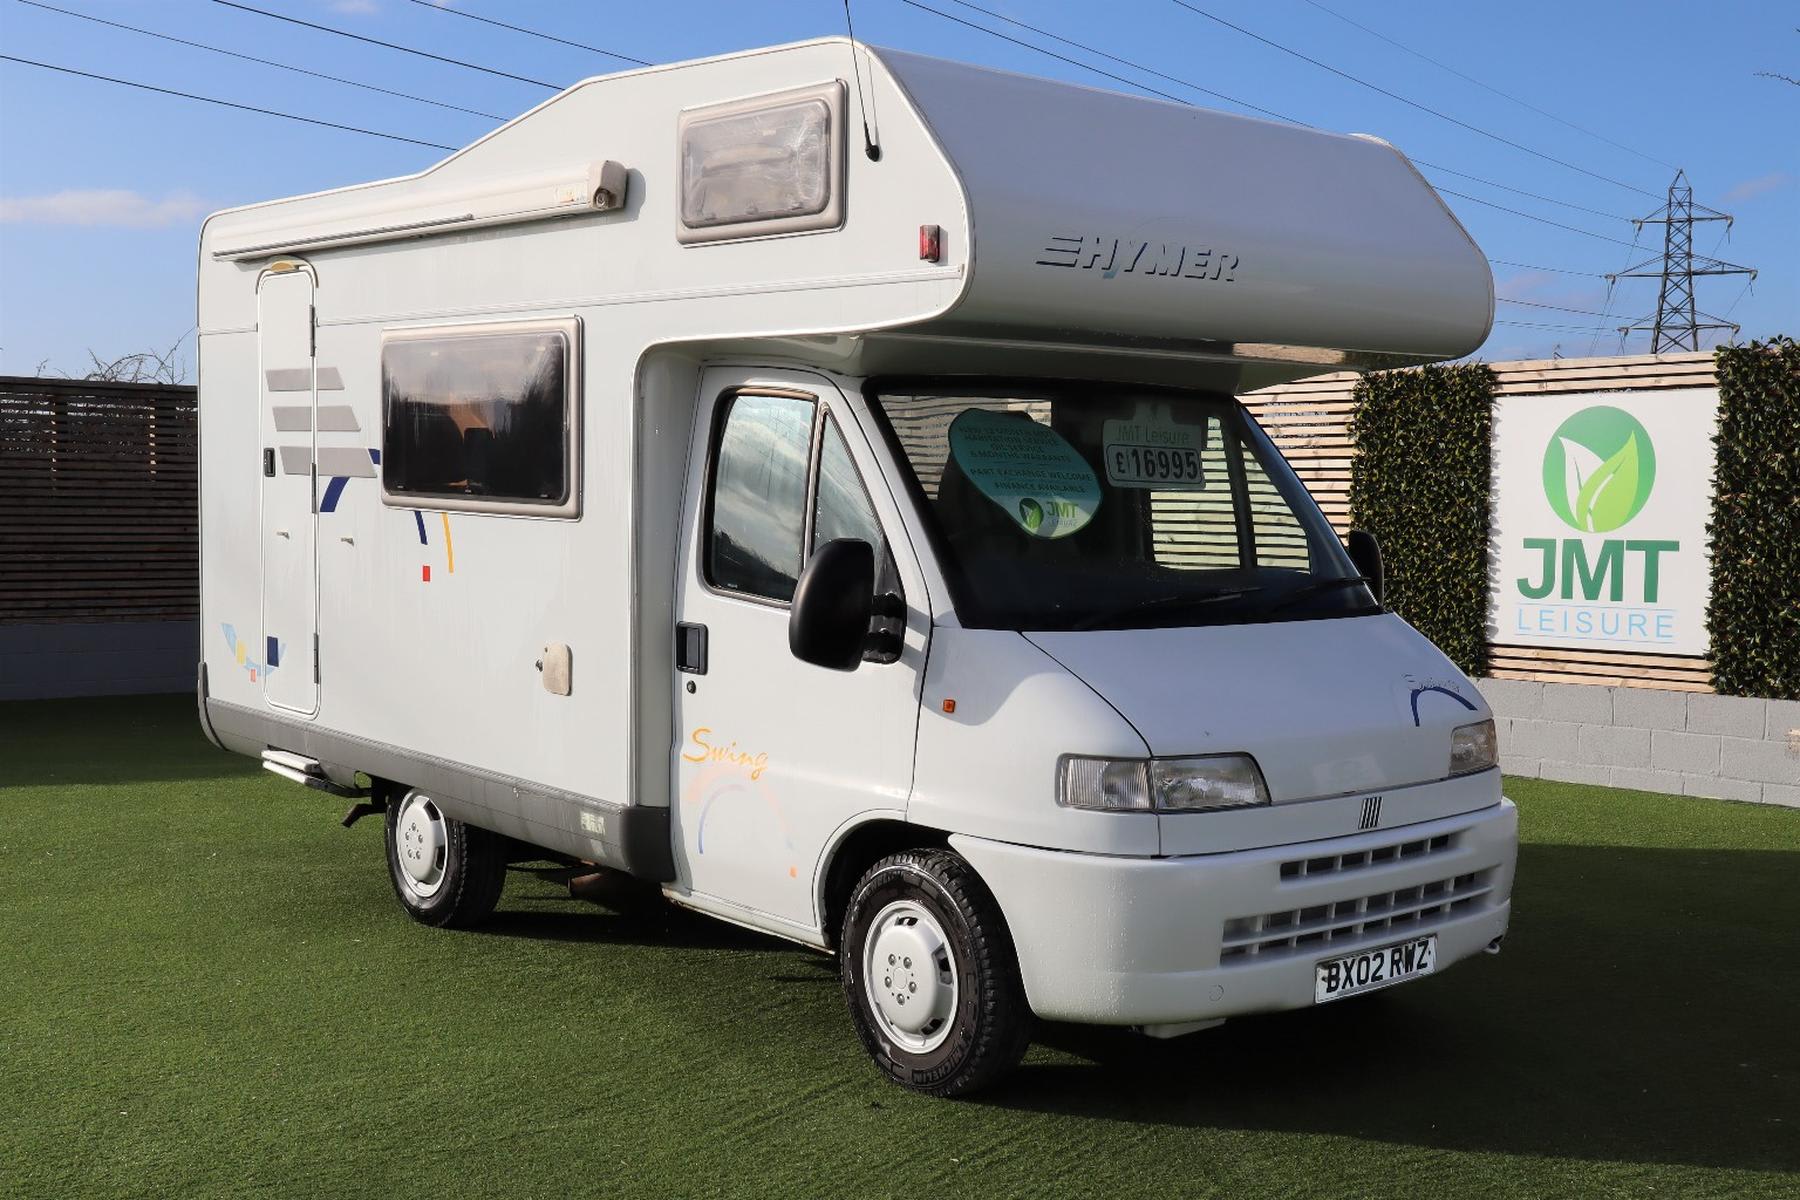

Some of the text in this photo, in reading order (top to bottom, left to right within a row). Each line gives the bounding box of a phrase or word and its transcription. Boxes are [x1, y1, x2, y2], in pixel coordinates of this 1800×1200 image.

[1046, 501, 1079, 518] JMT
[1516, 537, 1680, 603] JMT
[1517, 608, 1674, 639] LEISURE
[683, 728, 768, 780] Swing
[1326, 940, 1430, 993] BX02 RWZ
